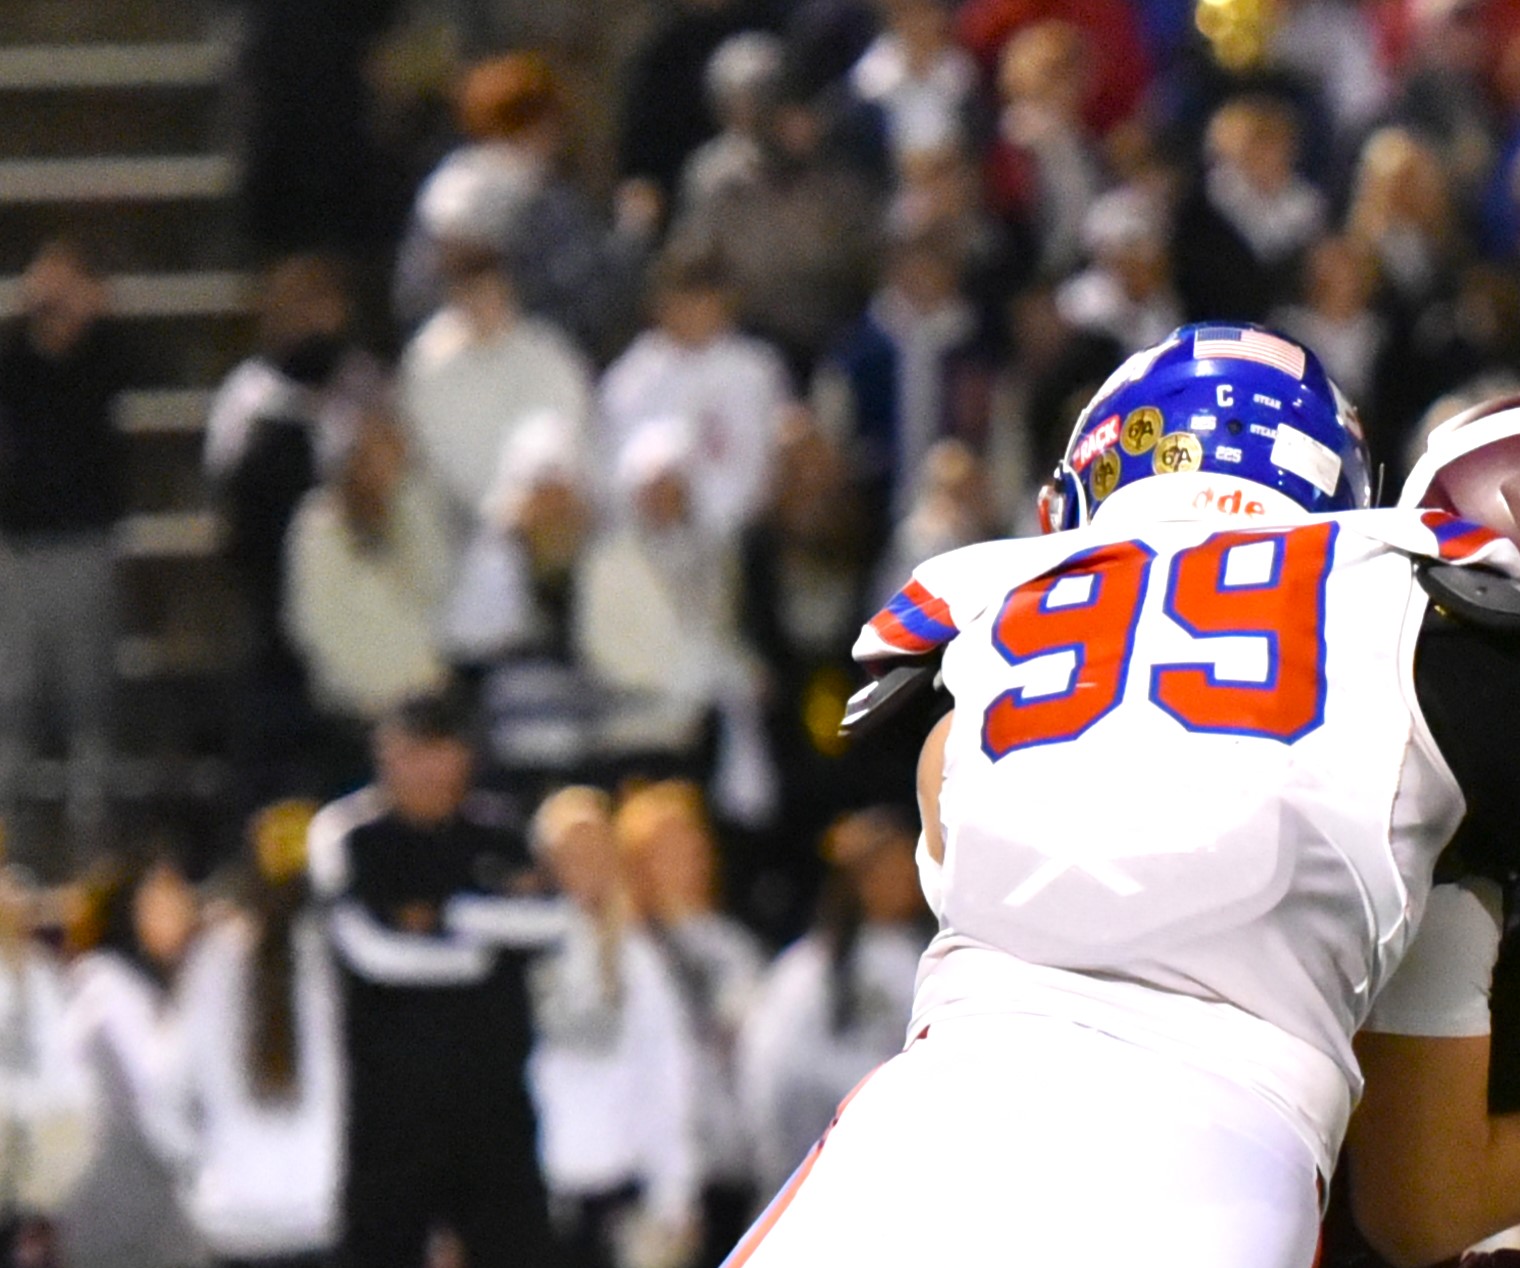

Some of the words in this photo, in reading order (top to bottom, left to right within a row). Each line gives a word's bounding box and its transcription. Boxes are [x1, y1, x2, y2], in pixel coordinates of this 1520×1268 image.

[1216, 384, 1234, 407] C
[1128, 420, 1154, 440] 6A
[1162, 446, 1192, 466] 6A
[980, 521, 1340, 763] 99
